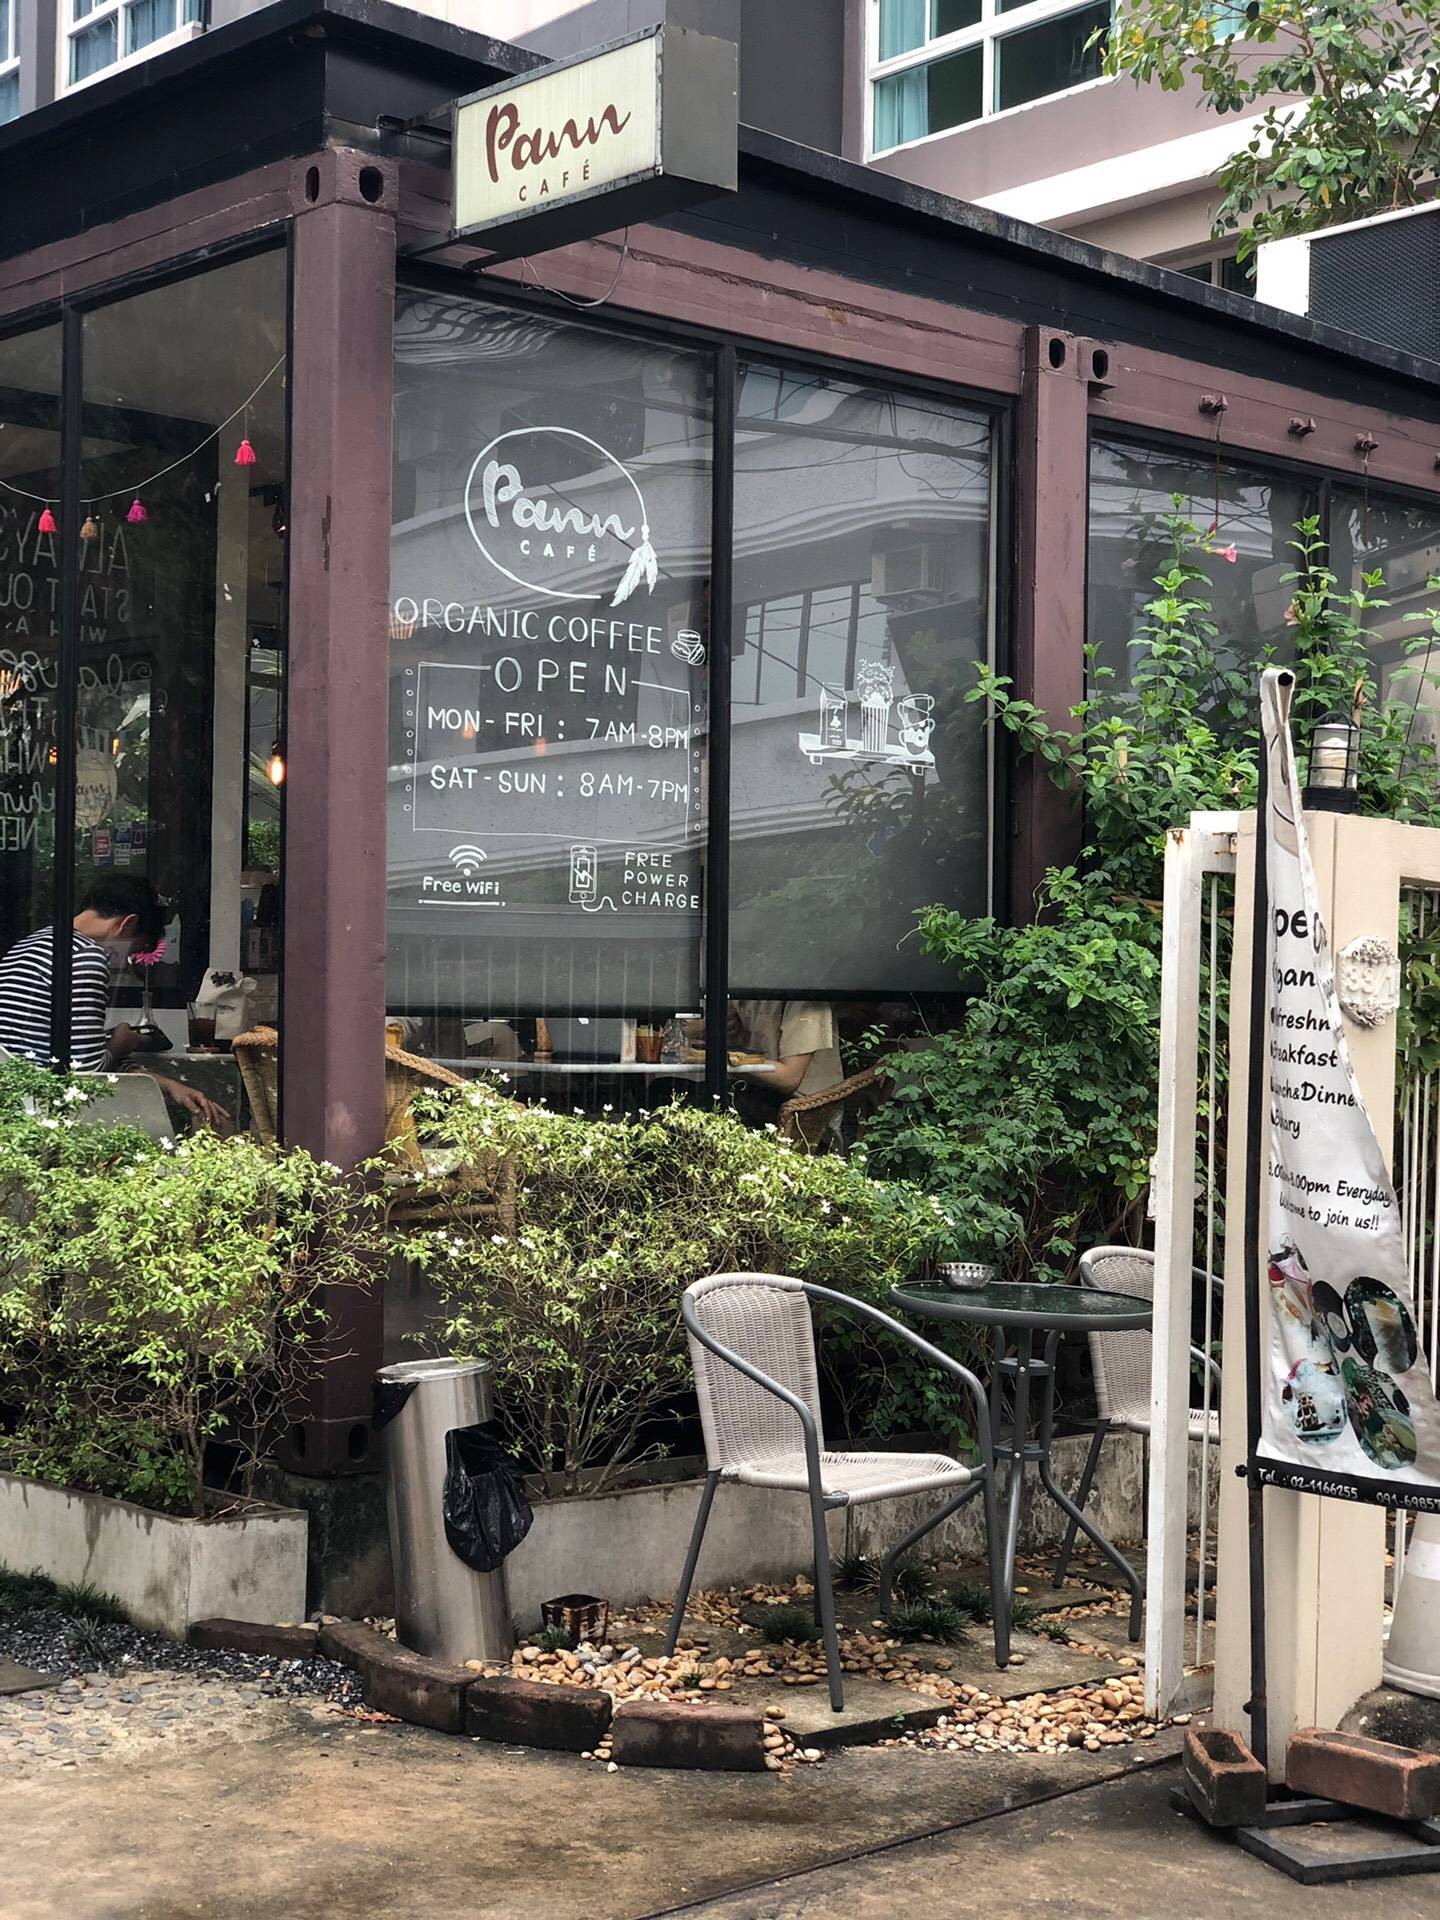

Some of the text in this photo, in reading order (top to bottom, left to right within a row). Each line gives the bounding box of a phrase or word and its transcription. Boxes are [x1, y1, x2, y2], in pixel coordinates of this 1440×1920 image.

[485, 102, 631, 183] Pann
[518, 160, 590, 202] CAFÉ
[482, 459, 635, 540] Pann
[519, 539, 596, 562] CAFÉ
[394, 597, 662, 654] ORGANIC COFFEE
[495, 657, 626, 695] OPEN
[625, 852, 673, 868] FREE
[422, 876, 462, 894] Free
[624, 871, 689, 888] POWER
[622, 891, 700, 910] CHARGE
[1308, 1206, 1321, 1222] to
[1323, 1208, 1349, 1228] join
[1354, 1214, 1380, 1231] us!!
